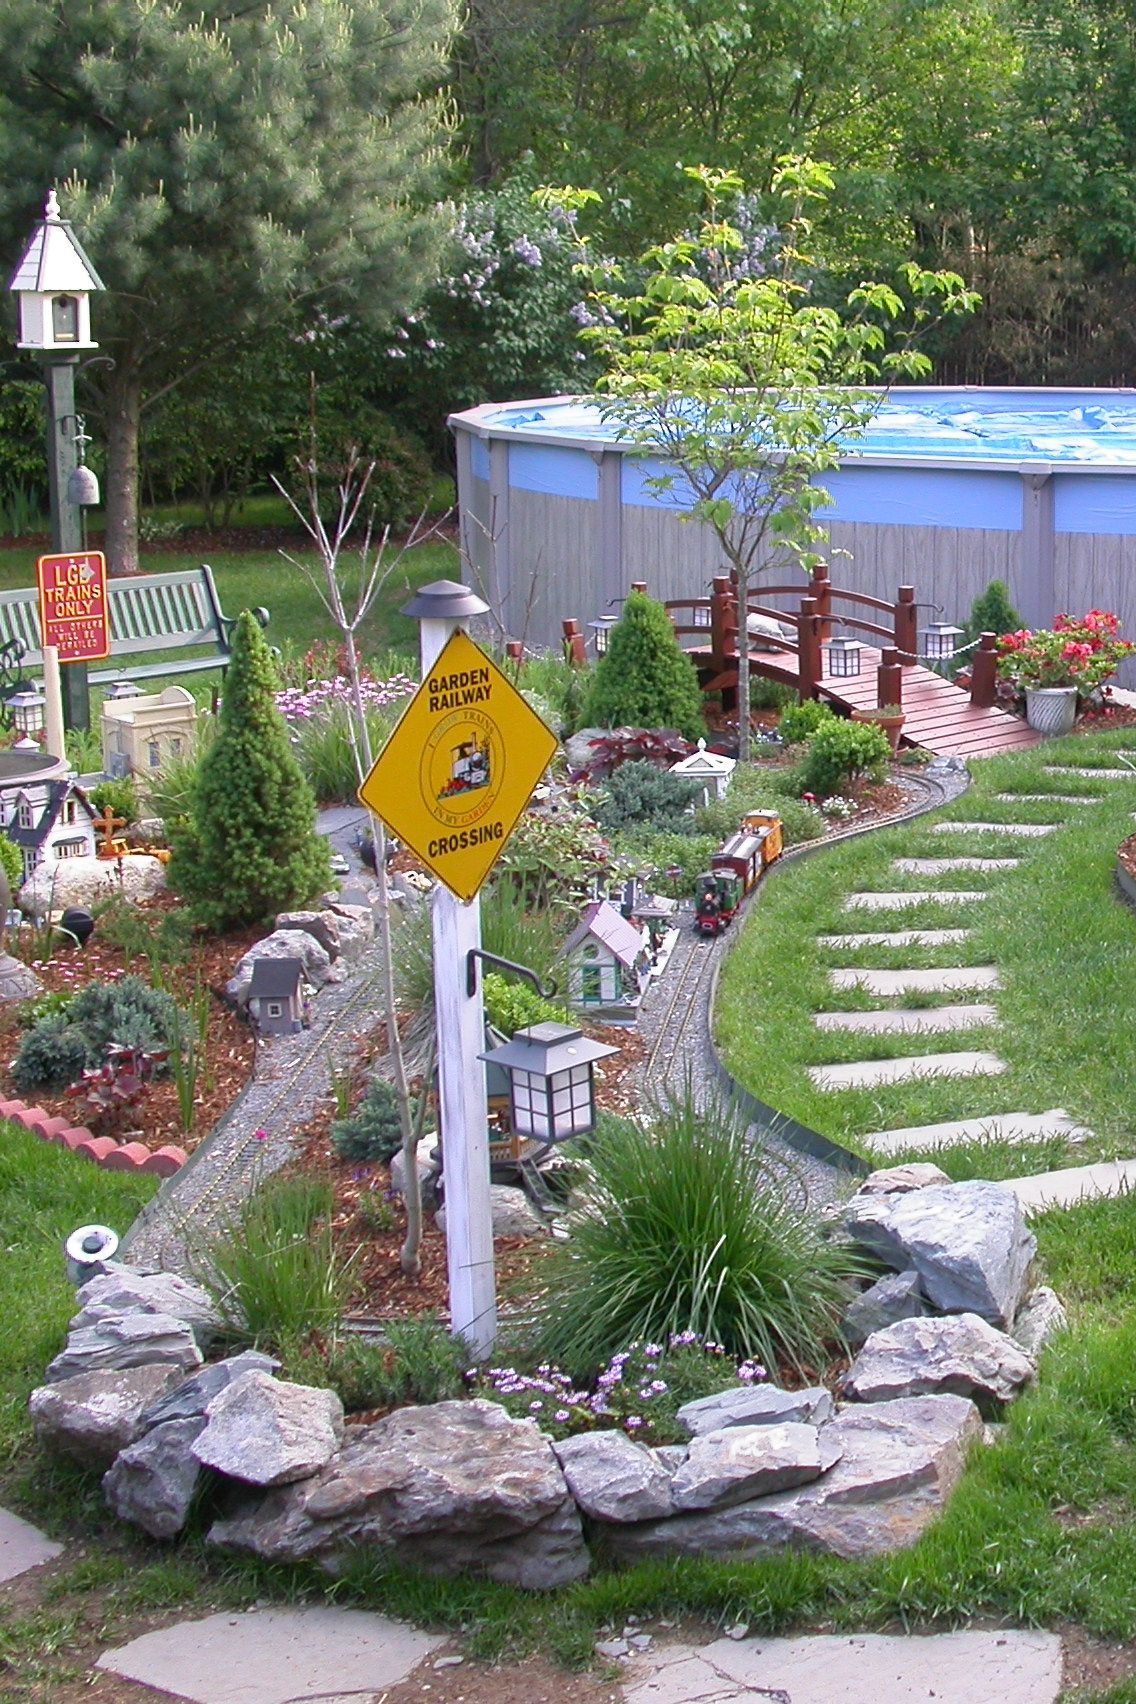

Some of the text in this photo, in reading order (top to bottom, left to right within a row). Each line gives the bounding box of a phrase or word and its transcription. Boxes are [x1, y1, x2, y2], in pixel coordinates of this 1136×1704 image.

[45, 583, 102, 603] TRAINS
[55, 600, 94, 617] ONLY
[428, 667, 490, 694] GARDEN
[429, 684, 493, 713] RAILWAY
[428, 821, 503, 859] CROSSING
